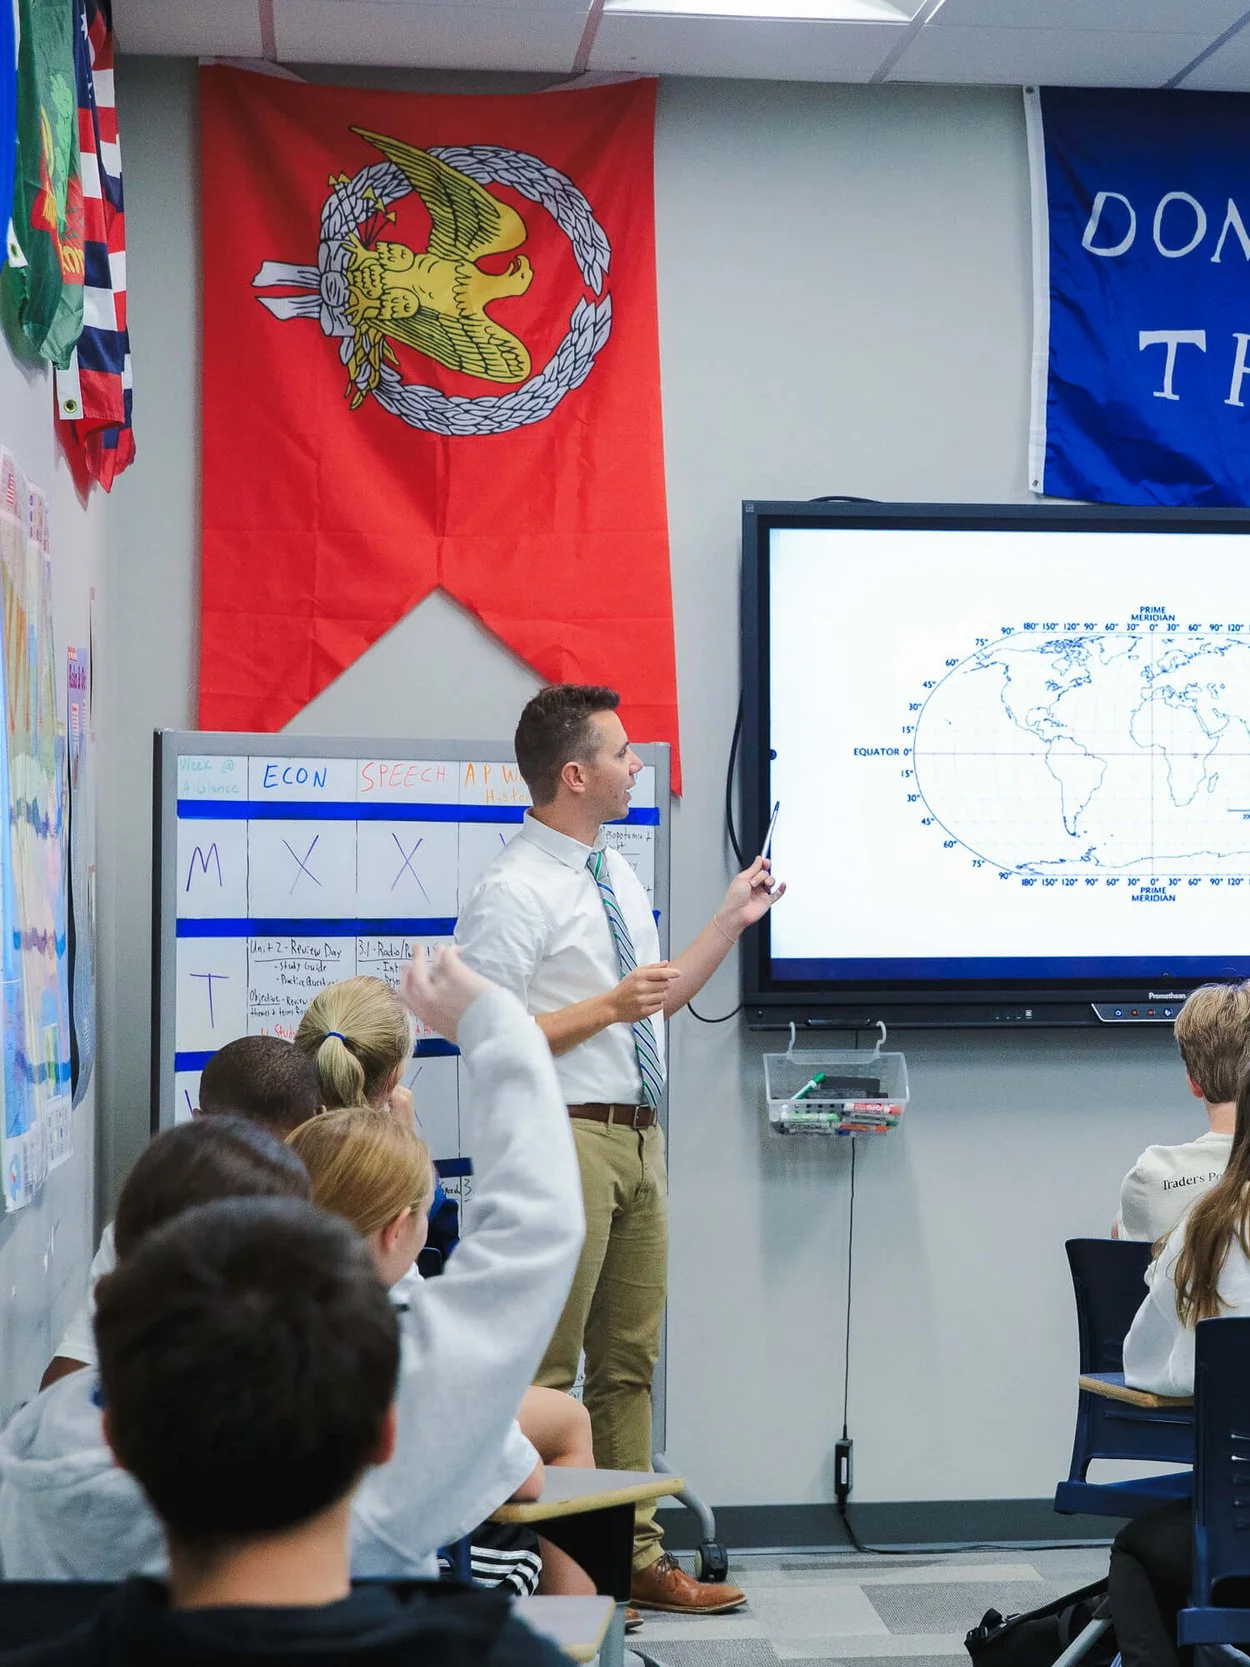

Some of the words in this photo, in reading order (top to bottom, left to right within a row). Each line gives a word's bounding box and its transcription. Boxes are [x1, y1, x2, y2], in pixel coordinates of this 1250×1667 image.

[1001, 626, 1014, 635] 90°
[1023, 623, 1039, 631] 180°
[1042, 623, 1059, 631] 150°
[1063, 623, 1080, 631] 120°
[1084, 623, 1097, 631] 90°
[1105, 623, 1118, 631] 60°
[1126, 623, 1139, 631] 30°
[1149, 623, 1158, 632] 0°
[1167, 623, 1180, 632] 30°
[1188, 623, 1202, 632] 60°
[1209, 623, 1223, 632] 90°
[1227, 623, 1244, 632] 120°
[975, 638, 989, 646] 75°
[945, 659, 959, 667] 60°
[908, 703, 922, 711] 30°
[853, 748, 900, 757] EQUATOR
[263, 764, 327, 788] ECON
[361, 762, 445, 792] SPEECH
[907, 794, 920, 802] 30°
[921, 818, 935, 826] 45°
[944, 840, 957, 848] 60°
[186, 842, 223, 892] M
[972, 860, 985, 868] 75°
[999, 872, 1012, 880] 90°
[1085, 878, 1098, 886] 90°
[1106, 878, 1120, 886] 60°
[1127, 878, 1140, 886] 30°
[1150, 878, 1159, 886] 0°
[1168, 878, 1181, 886] 30°
[1188, 878, 1202, 886] 60°
[1210, 878, 1223, 886] 90°
[1227, 878, 1244, 886] 120°
[291, 939, 321, 956] Review
[190, 973, 229, 1029] T
[1163, 1175, 1205, 1190] Traders
